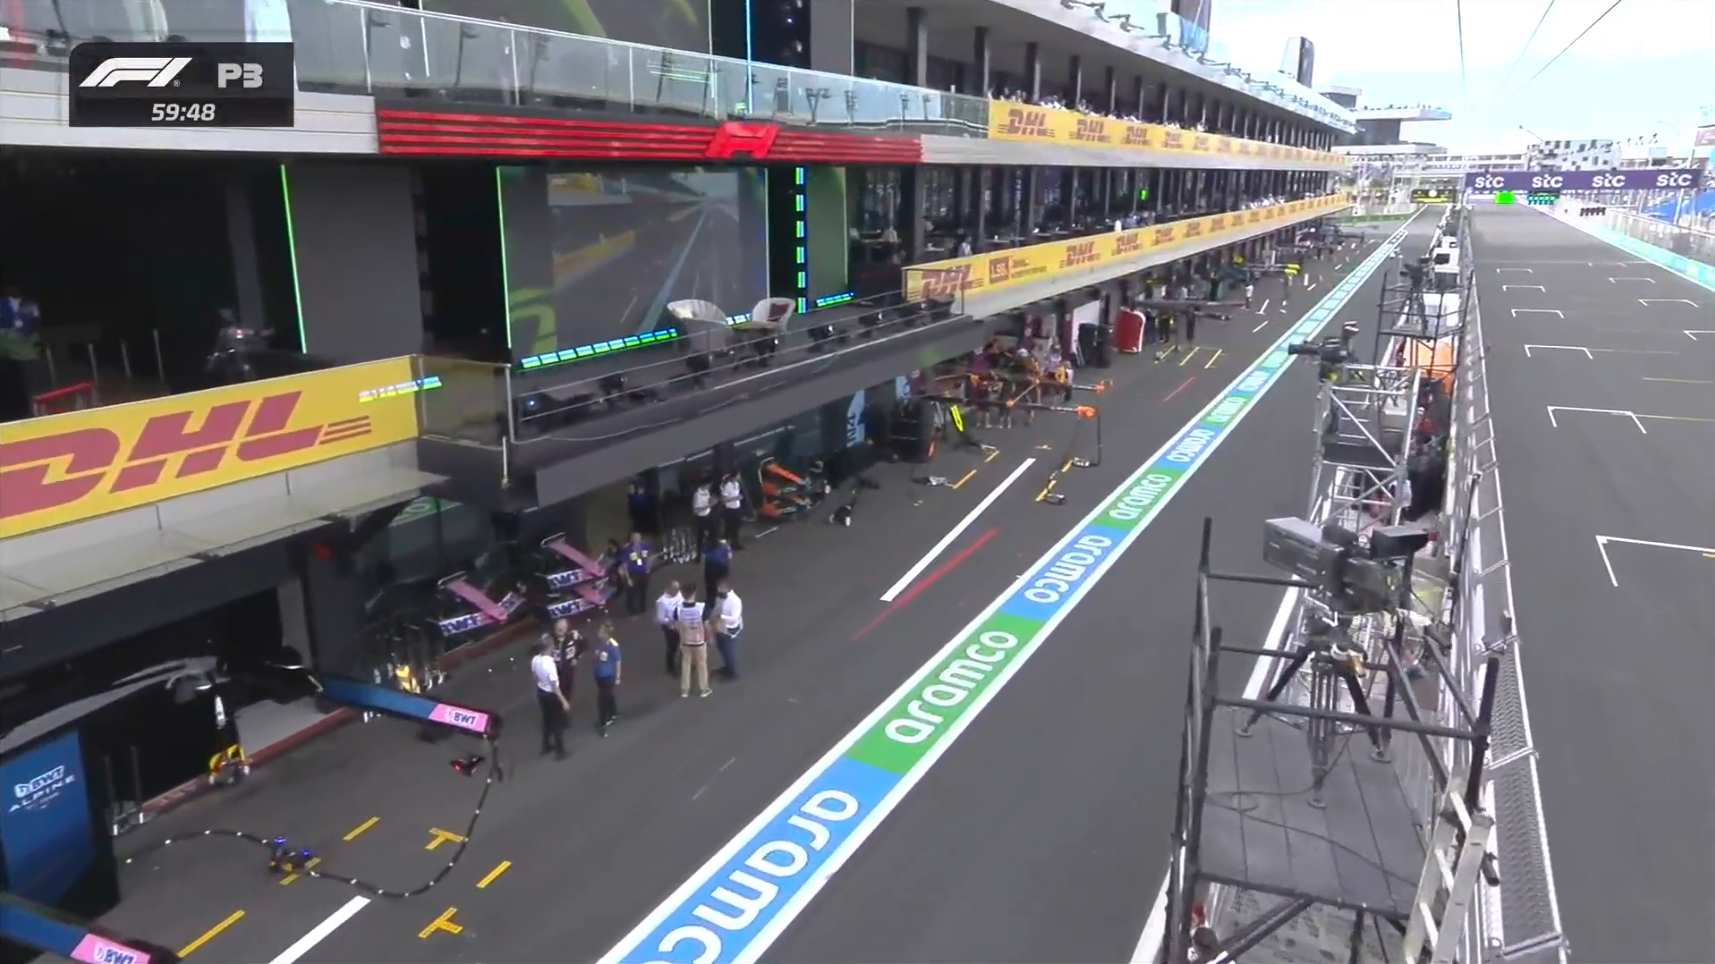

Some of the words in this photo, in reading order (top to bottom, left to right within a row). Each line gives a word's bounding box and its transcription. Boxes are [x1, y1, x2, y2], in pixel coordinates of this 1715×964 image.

[1004, 109, 1048, 137] DHL
[1475, 174, 1505, 188] stc
[1532, 174, 1563, 188] stc
[1592, 173, 1626, 188] stc
[1656, 172, 1692, 187] stc
[1066, 241, 1099, 267] DHL
[0, 391, 324, 518] DHL
[1109, 474, 1172, 520] aramco
[1024, 535, 1112, 603] aramco
[885, 631, 1018, 743] aramco
[453, 712, 476, 725] BWT
[643, 790, 859, 964] aramc
